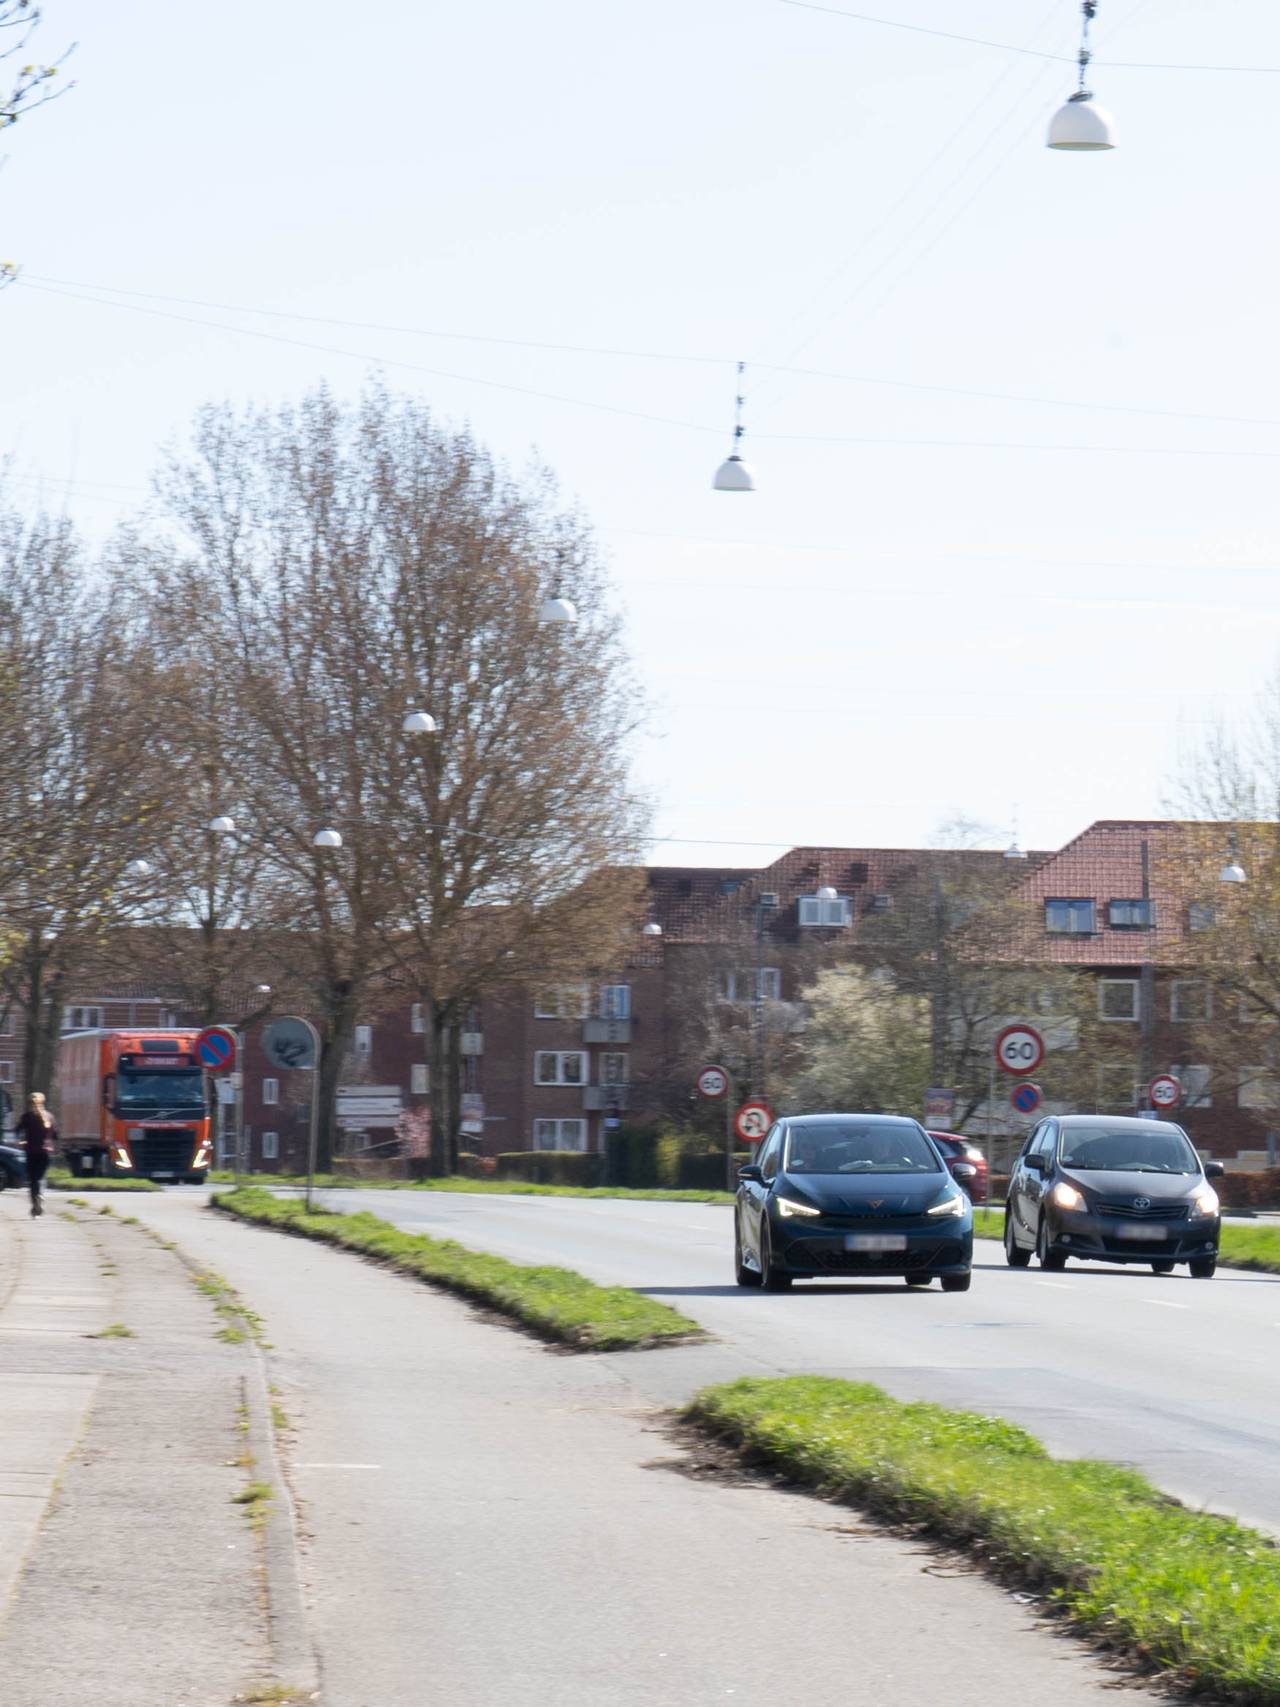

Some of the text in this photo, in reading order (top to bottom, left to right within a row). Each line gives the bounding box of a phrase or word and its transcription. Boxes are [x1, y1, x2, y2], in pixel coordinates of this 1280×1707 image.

[1005, 1041, 1035, 1060] 60
[702, 1077, 724, 1089] 60
[1154, 1086, 1175, 1098] 60
